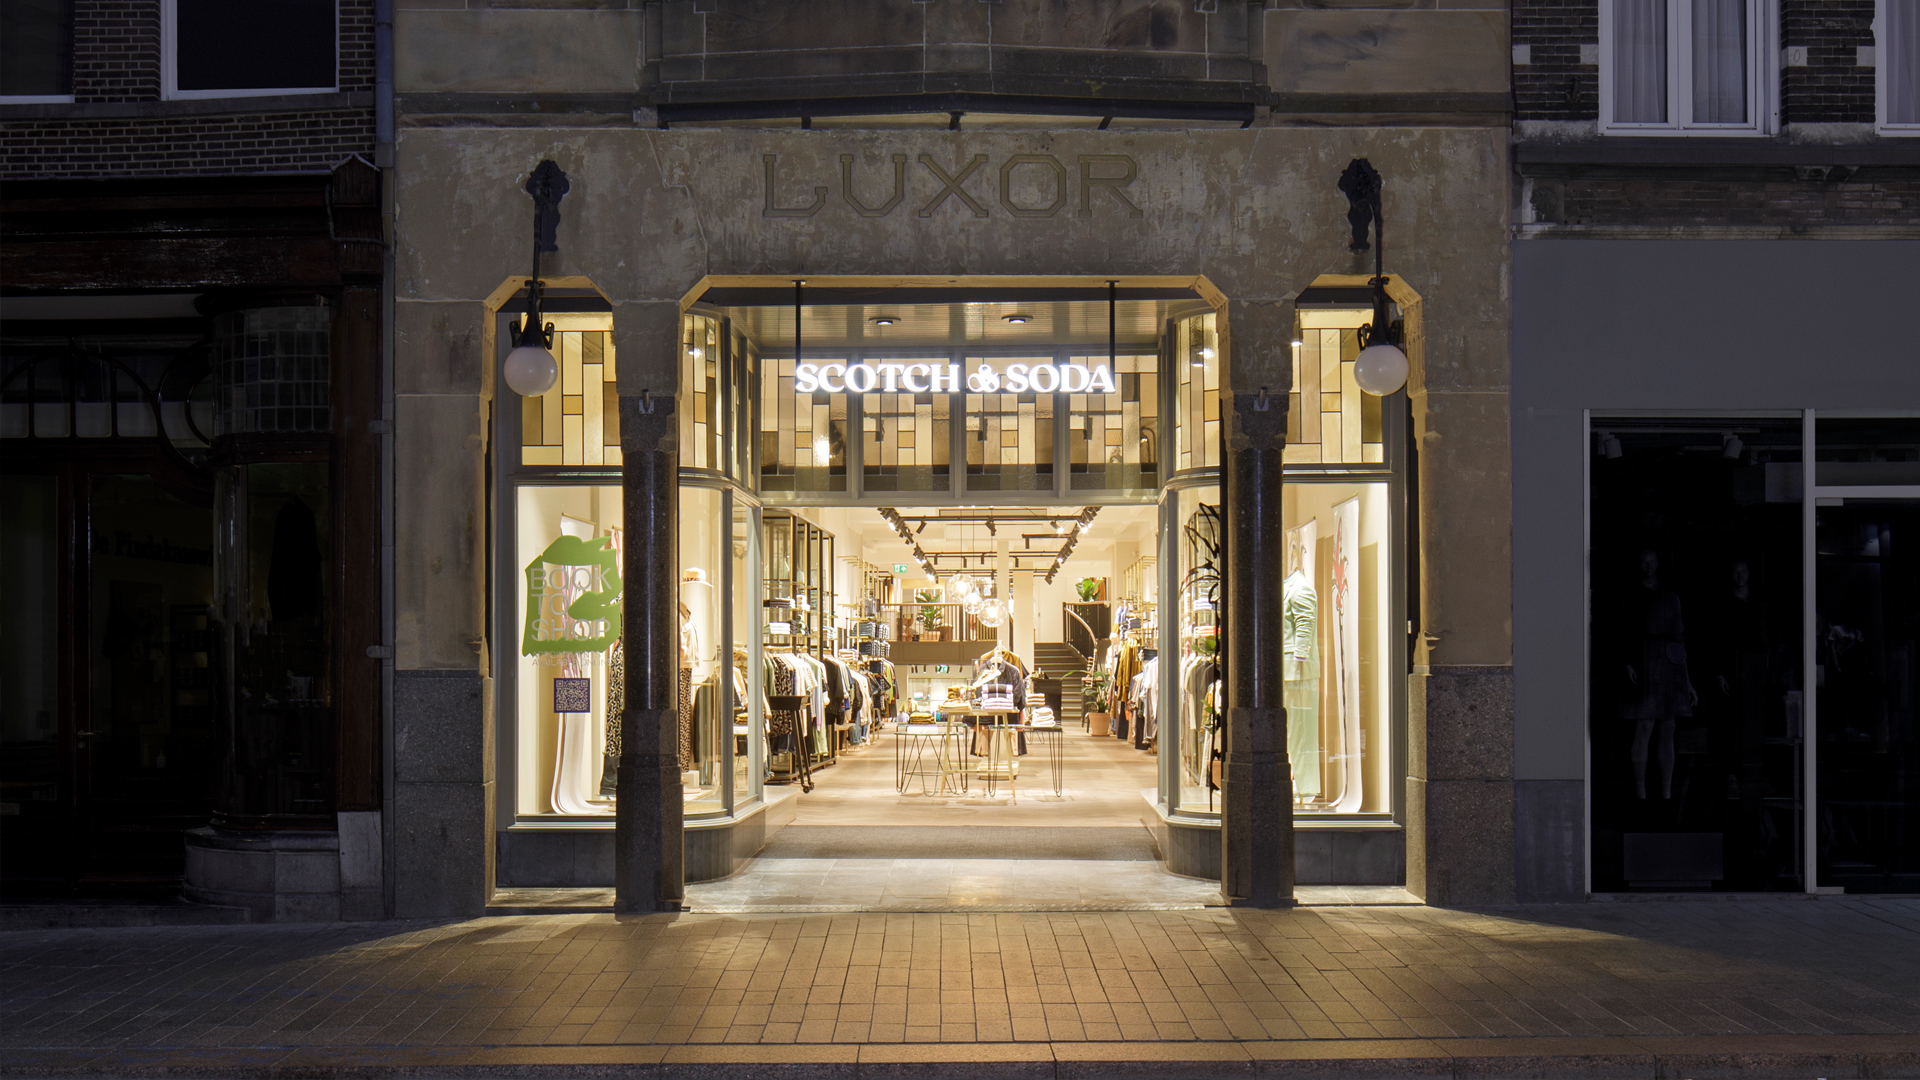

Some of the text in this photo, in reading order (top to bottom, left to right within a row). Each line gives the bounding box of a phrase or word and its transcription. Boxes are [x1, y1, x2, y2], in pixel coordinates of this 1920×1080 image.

[763, 153, 1144, 219] LUXOR
[795, 363, 1116, 393] SCOTCH & SODA
[530, 567, 613, 590] BOOK
[530, 593, 570, 616] TO
[531, 618, 612, 642] SHOP
[532, 658, 577, 667] AVAILABLE
